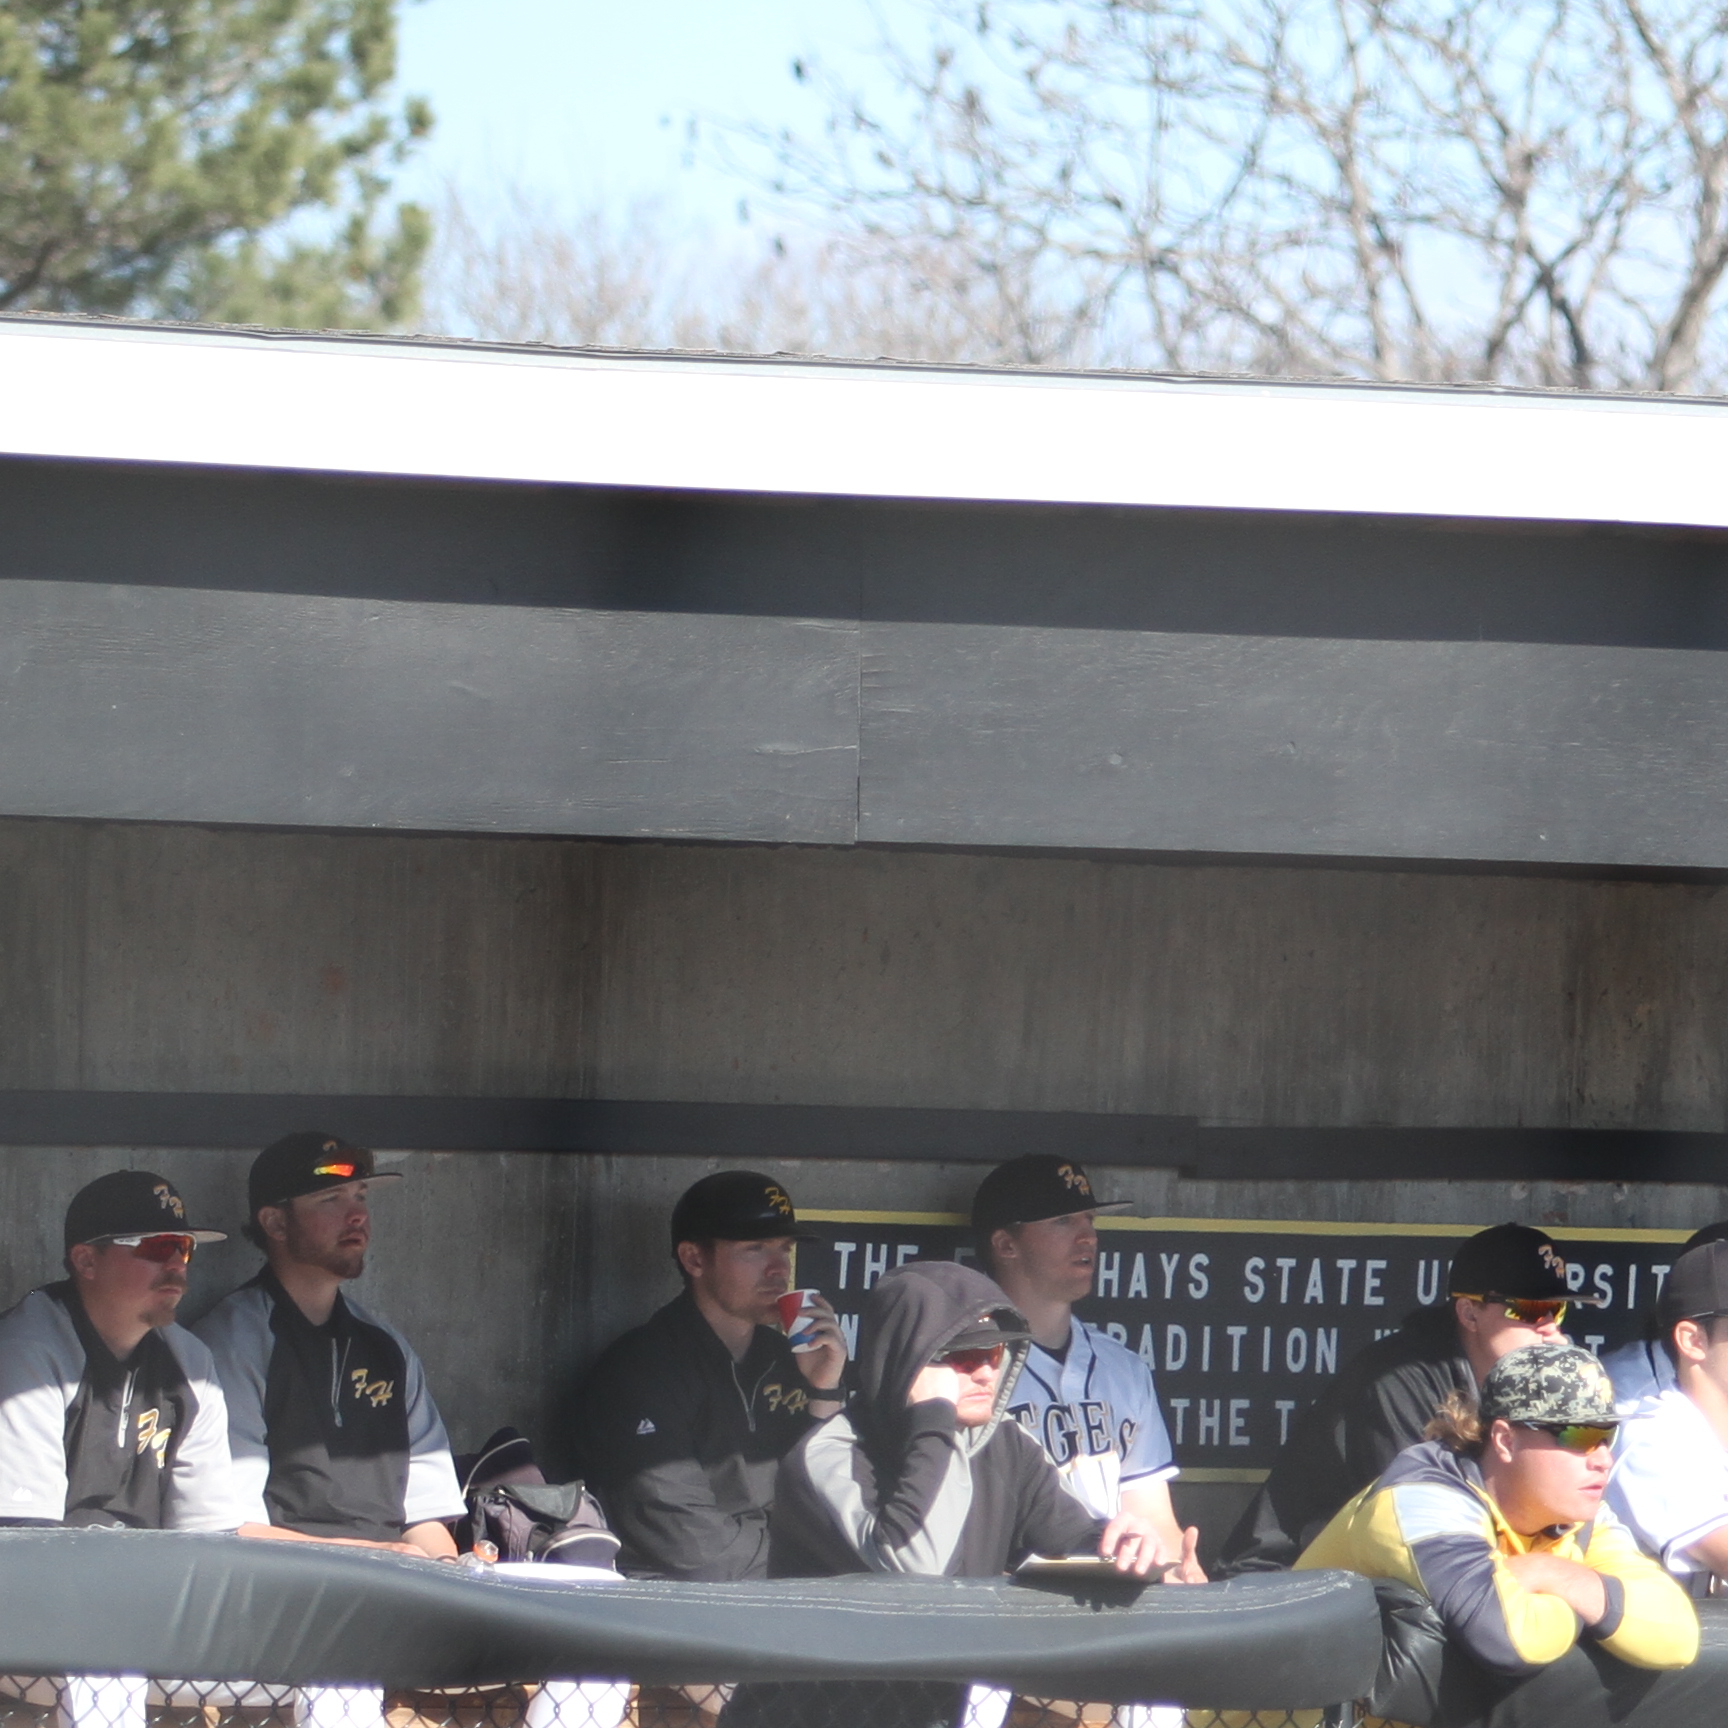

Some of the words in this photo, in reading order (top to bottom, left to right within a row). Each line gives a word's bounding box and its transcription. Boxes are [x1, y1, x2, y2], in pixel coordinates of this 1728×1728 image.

[1098, 1251, 1210, 1300] HAYS
[1243, 1256, 1387, 1306] STATE
[1082, 1321, 1338, 1374] ADITION
[351, 1367, 395, 1408] FH
[1170, 1398, 1250, 1446] THE
